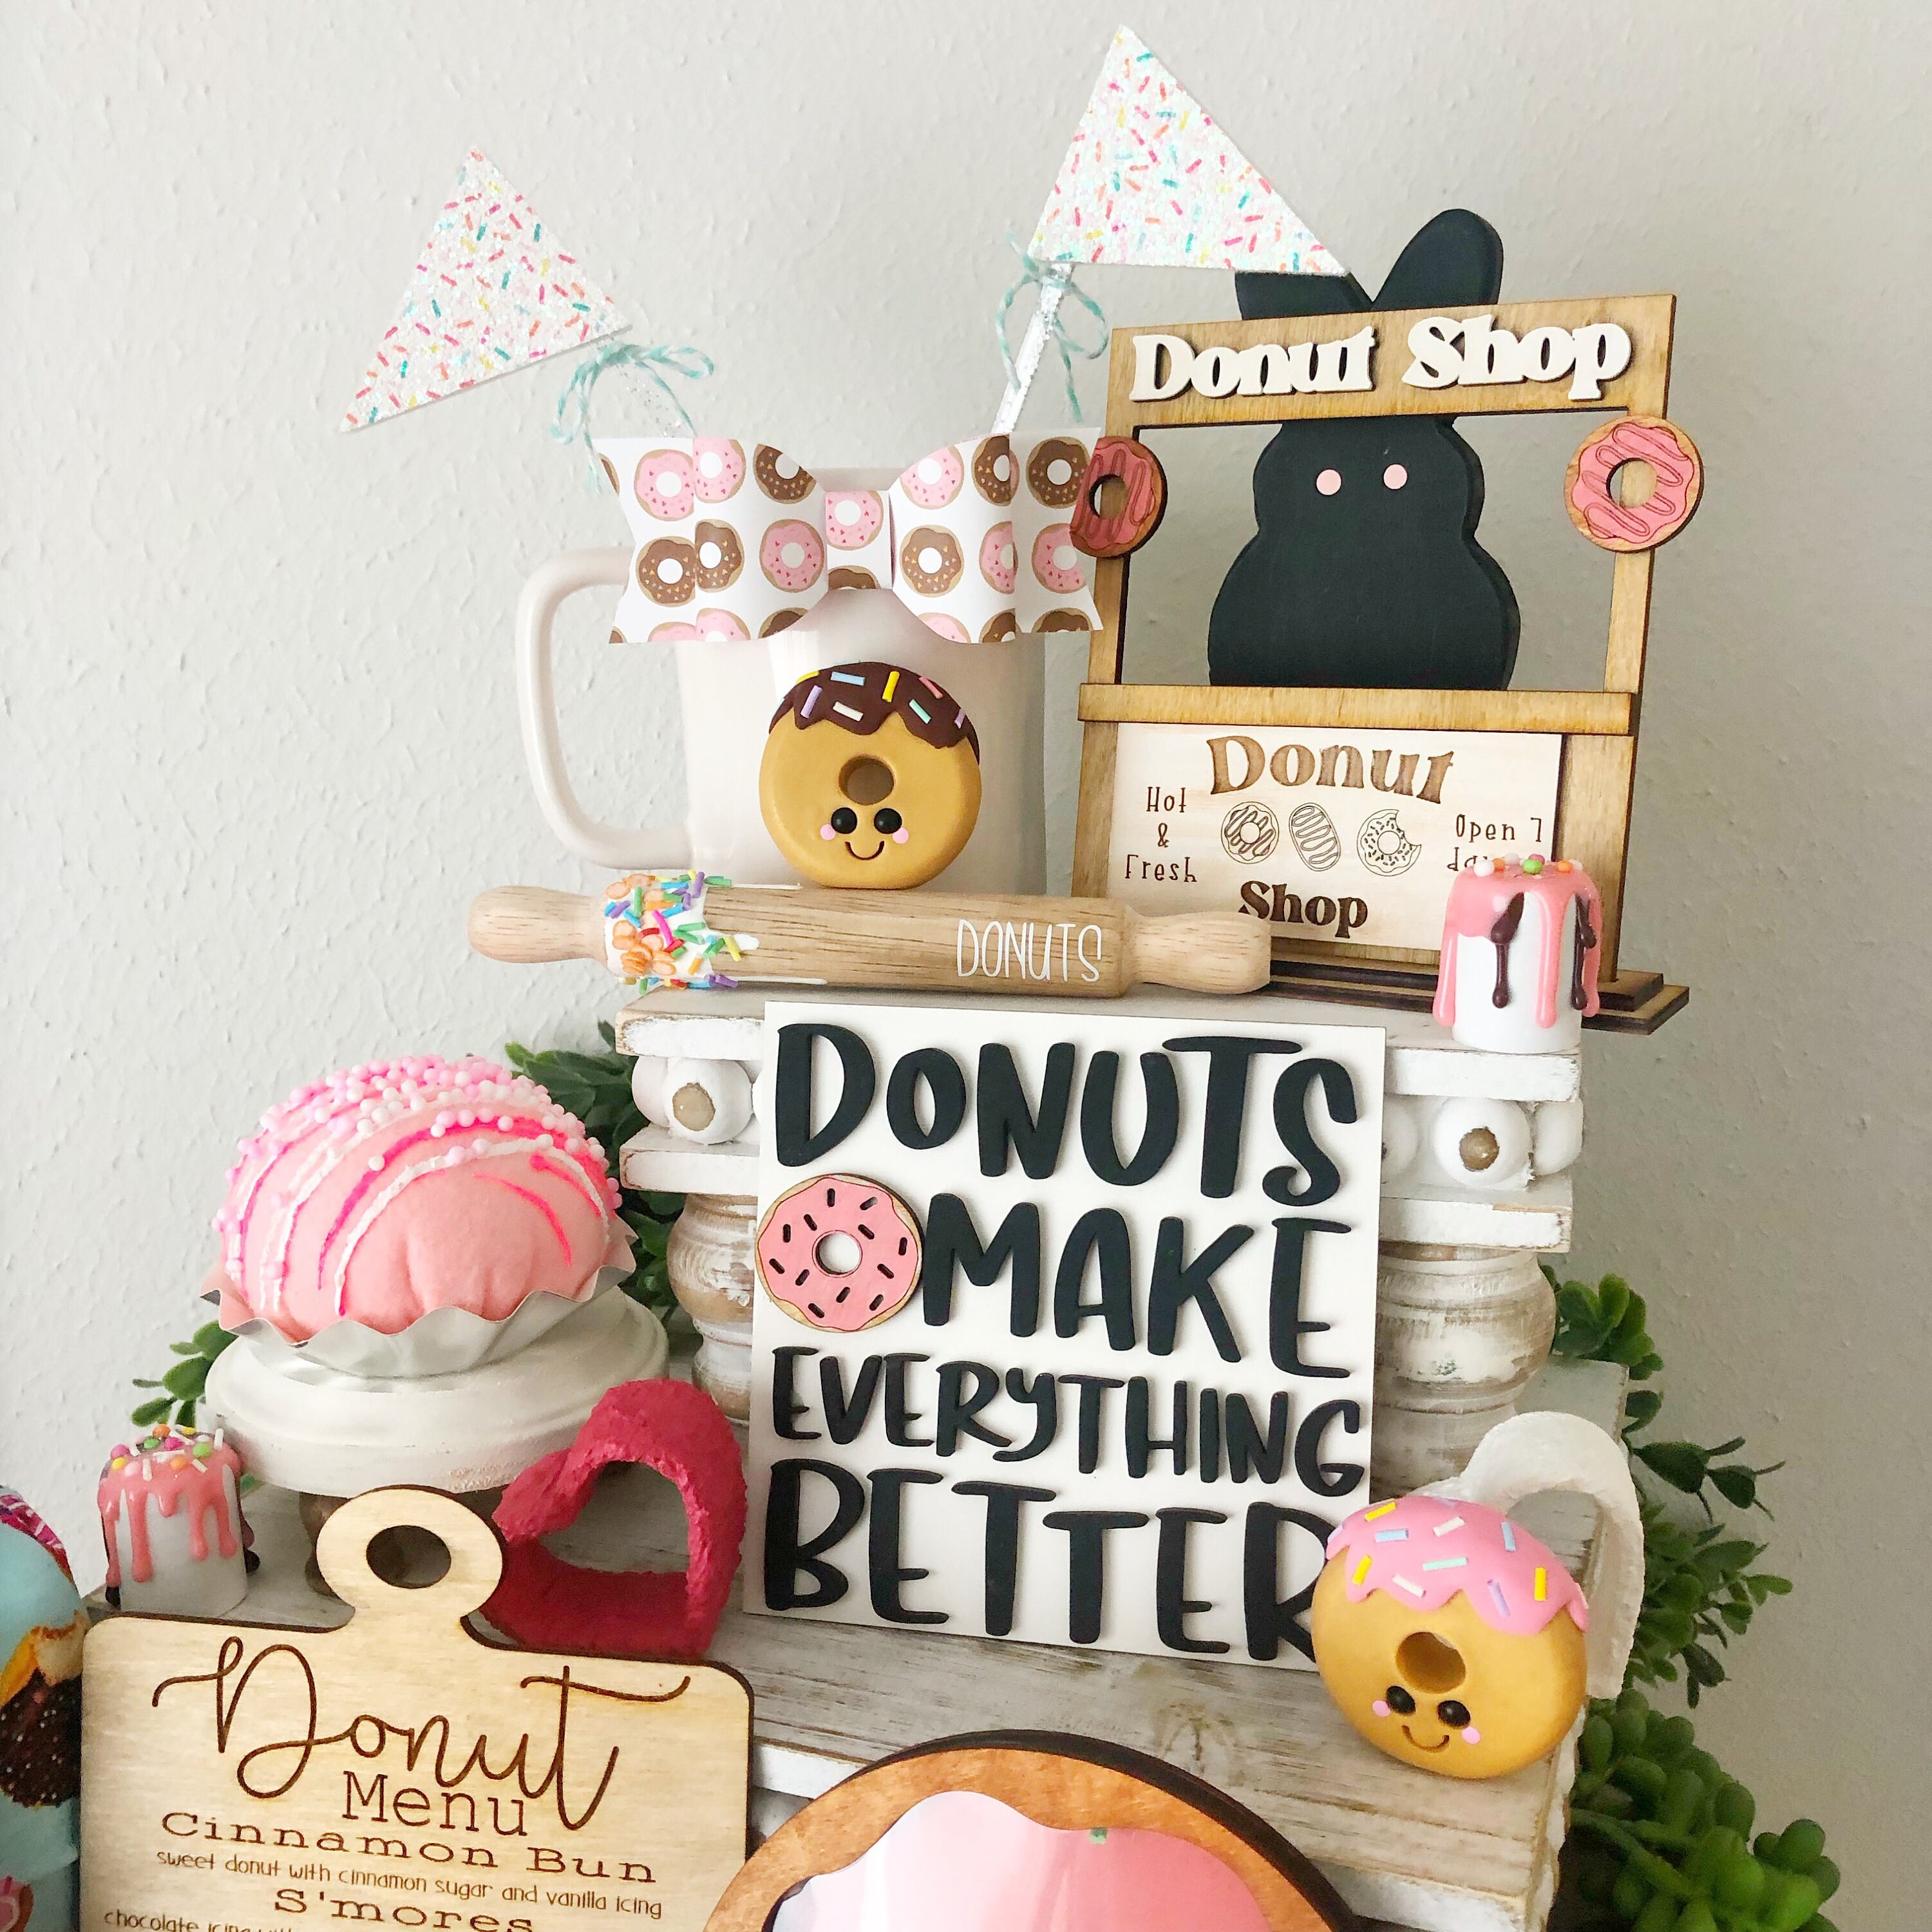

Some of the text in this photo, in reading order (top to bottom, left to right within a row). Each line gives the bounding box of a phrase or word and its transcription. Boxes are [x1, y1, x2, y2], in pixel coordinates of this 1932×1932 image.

[1130, 314, 1632, 402] Donut Shop
[1146, 786, 1187, 813] Hot
[1206, 735, 1454, 804] Donut
[1157, 822, 1170, 848] &
[1455, 813, 1542, 843] Open 7
[1124, 854, 1197, 883] Fresh
[1238, 880, 1368, 938] Shop
[956, 919, 1102, 982] DONUTS
[775, 1022, 1358, 1207] DONUTS
[922, 1193, 1352, 1379] MAKE
[771, 1345, 1365, 1497] EVERYTHING
[763, 1458, 1336, 1663] BETTER
[152, 1636, 691, 1832] Donut
[341, 1770, 527, 1837] Menu
[161, 1811, 656, 1883] Cinnamon Bun
[156, 1851, 663, 1920] sweet donut with cinnamon sugar and vanilla icing
[274, 1888, 533, 1932] S'mores
[104, 1908, 198, 1932] chocolate
